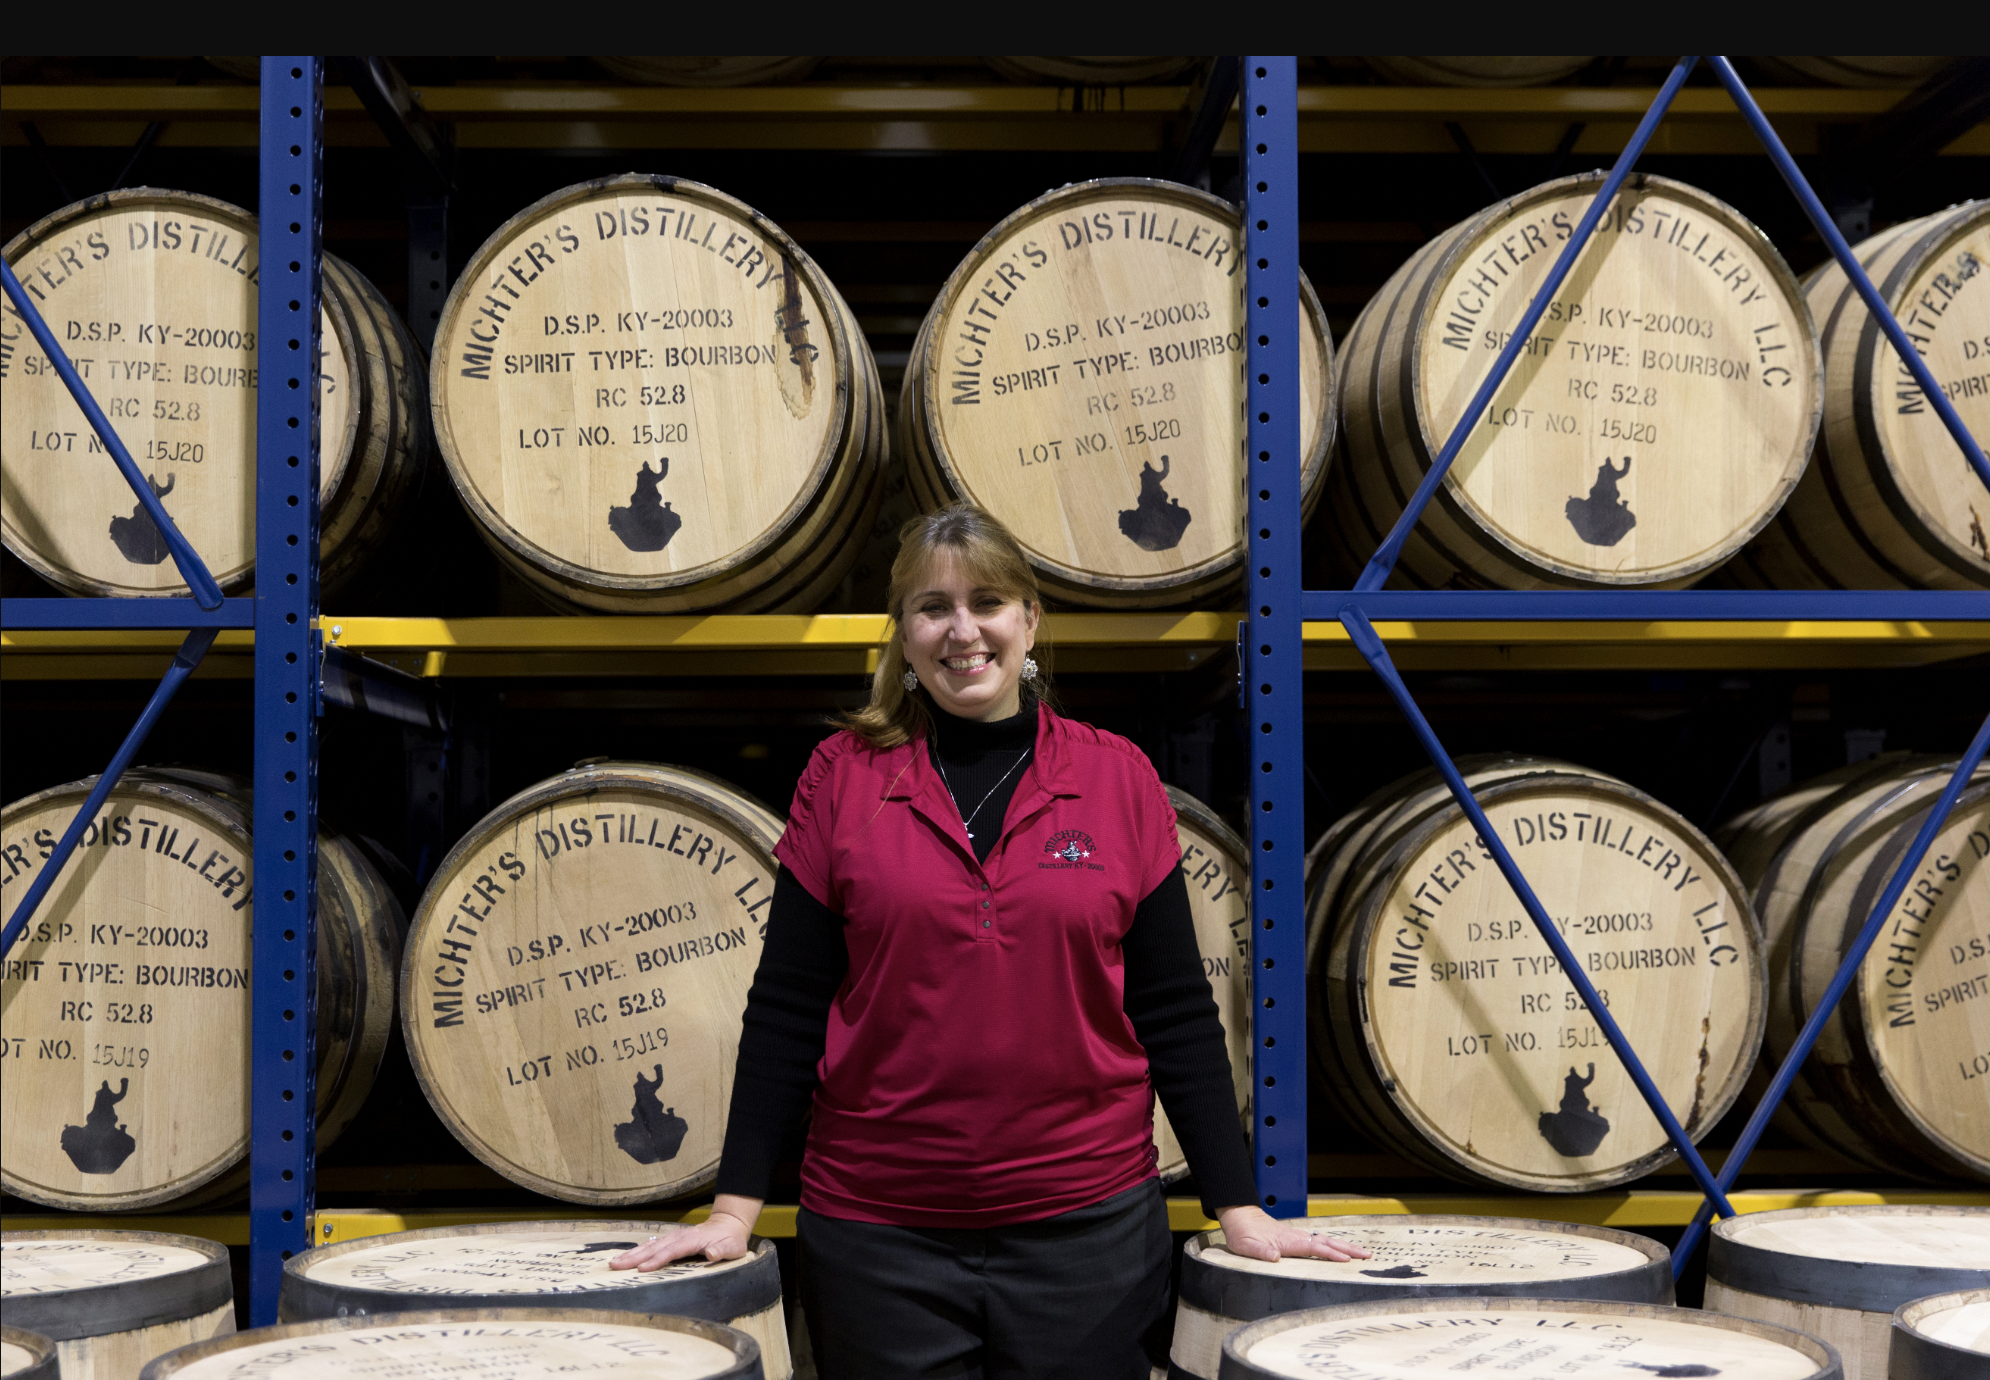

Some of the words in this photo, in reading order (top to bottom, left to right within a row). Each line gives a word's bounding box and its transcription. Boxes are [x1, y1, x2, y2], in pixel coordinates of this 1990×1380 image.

[460, 225, 580, 380] MICHTER'S
[595, 206, 782, 290] DISTILLERY
[774, 299, 819, 365] LLC
[1442, 211, 1574, 351] MICHTER'S
[1594, 205, 1766, 307] DISTILLERY
[1754, 322, 1792, 388] LLC
[544, 315, 605, 336] D.S.P.
[617, 309, 733, 333] KY-20003
[951, 239, 1048, 405] MICHTER'S
[1025, 324, 1086, 352] D.S.P.
[1097, 301, 1210, 338] KY-20003
[1530, 299, 1586, 324] .S.P.
[1600, 307, 1713, 339] KY-20003
[67, 321, 126, 343] D.S.P.
[139, 324, 255, 351] KY-20003
[24, 356, 94, 378] SPIT
[108, 360, 171, 382] TYPE:
[504, 353, 575, 374] SPIRIT
[588, 348, 654, 370] TYPE:
[665, 344, 776, 368] BOURBON
[1484, 330, 1554, 358] SPRIT
[1567, 341, 1630, 368] TYPE:
[1642, 349, 1751, 381] BOURBON
[992, 365, 1061, 396] SPIRIT
[1073, 353, 1139, 381] TYPE:
[110, 398, 140, 418] RC
[153, 401, 201, 421] 52.8
[596, 388, 627, 409] RC
[640, 384, 686, 406] 52.8
[1087, 392, 1118, 416] RC
[1131, 382, 1176, 408] 52.8
[1568, 378, 1598, 401] RC
[1611, 384, 1657, 408] 52.8
[519, 427, 565, 449] LOT
[578, 426, 615, 447] NO.
[632, 423, 688, 445] 15J20
[1488, 405, 1535, 429] LOT
[1546, 412, 1582, 436] NO.
[1599, 418, 1657, 445] 15J20
[31, 431, 77, 450] LOT
[147, 440, 204, 463] 15J20
[1019, 440, 1062, 467] LOT
[1075, 433, 1113, 457] NO.
[1125, 419, 1181, 446] 15J20
[1044, 829, 1097, 853] MICHTER'S
[1514, 812, 1700, 892] DISTILLERY
[1693, 901, 1738, 967] LLC
[90, 924, 209, 949] KY-20003
[433, 851, 526, 1029] MICHTER'S
[535, 814, 737, 876] DISTILLERY
[508, 935, 570, 967] D.S.P.
[580, 901, 697, 949] KY-20003
[1468, 921, 1528, 942] D.S.P.
[1551, 912, 1653, 936] Y-20003
[1885, 854, 1961, 1029] MICHTER'S
[58, 962, 124, 984] TYPE:
[136, 965, 249, 989] BOURBON
[475, 978, 546, 1014] SPIRIT
[559, 960, 627, 992] TYPE:
[635, 926, 747, 973] BOURBON
[1430, 958, 1499, 982] SPIRIT
[1588, 946, 1696, 972] BOURBON
[61, 1001, 93, 1023] RC
[106, 1002, 153, 1025] 52.8
[574, 1003, 608, 1029] RC
[619, 987, 666, 1017] 52.8
[1521, 993, 1551, 1014] RC
[39, 1039, 76, 1060] NO.
[92, 1043, 150, 1069] 15J19
[507, 1055, 552, 1086] LOT
[566, 1044, 604, 1072] NO.
[612, 1026, 669, 1062] 15J19
[1448, 1034, 1492, 1057] LOT
[1505, 1032, 1542, 1052] NO.
[350, 1328, 614, 1345] DISTILLERY
